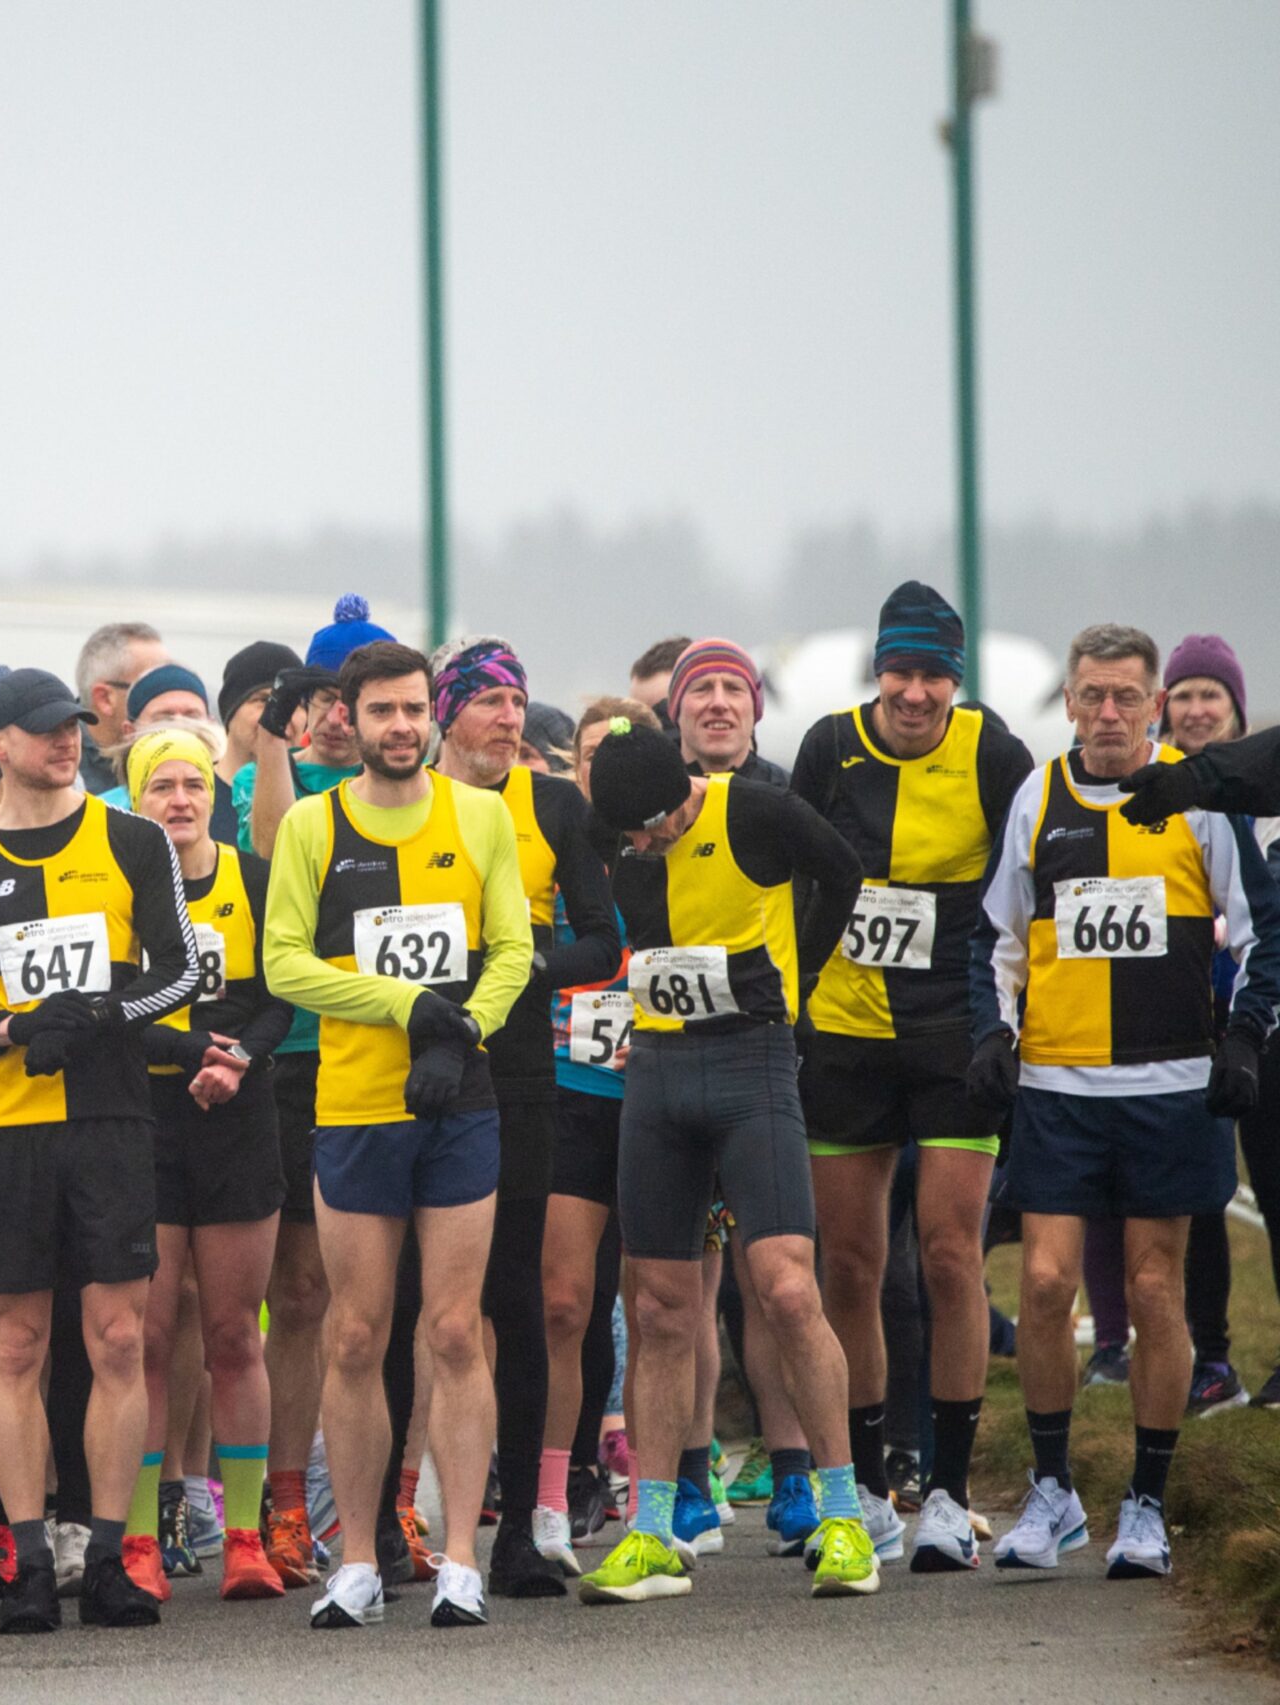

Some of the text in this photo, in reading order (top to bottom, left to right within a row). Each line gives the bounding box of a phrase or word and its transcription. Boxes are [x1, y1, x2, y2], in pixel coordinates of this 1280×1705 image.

[425, 852, 456, 869] NB
[847, 913, 921, 964] 597
[1073, 905, 1151, 954] 666
[21, 941, 95, 996] 647
[375, 931, 452, 980] 632
[649, 974, 717, 1017] 681
